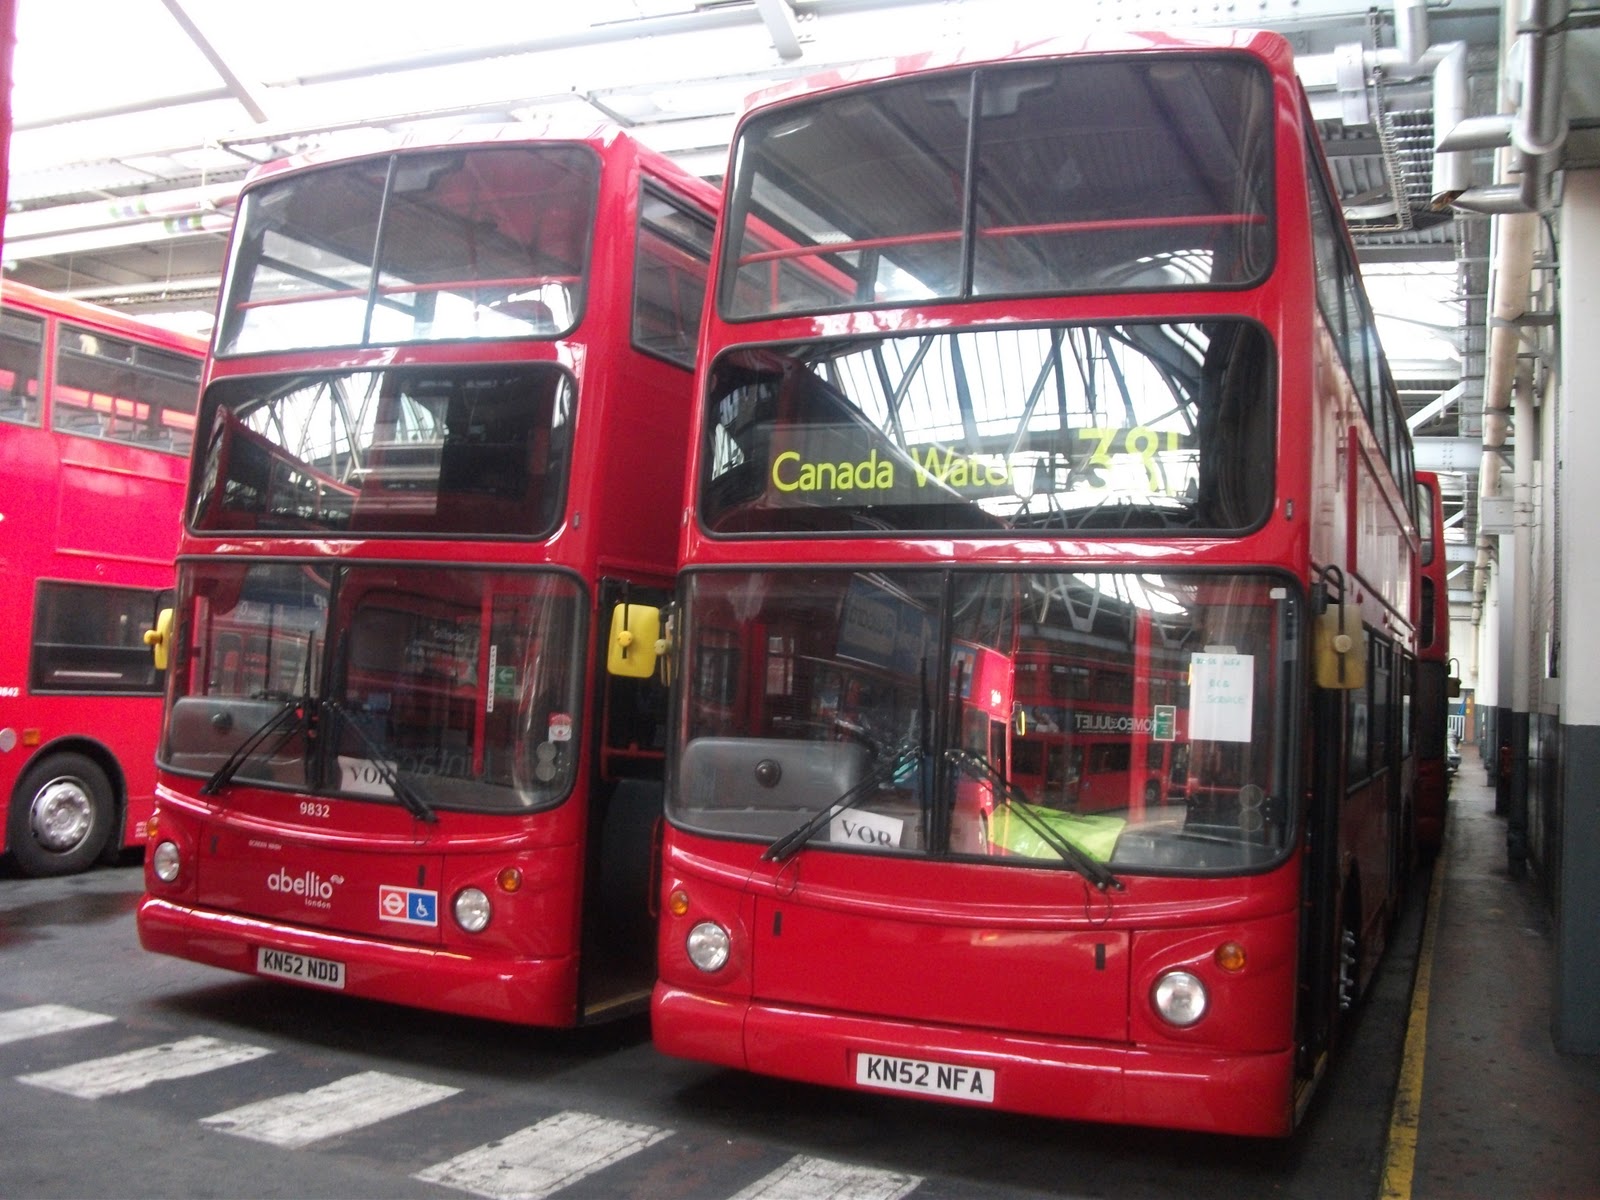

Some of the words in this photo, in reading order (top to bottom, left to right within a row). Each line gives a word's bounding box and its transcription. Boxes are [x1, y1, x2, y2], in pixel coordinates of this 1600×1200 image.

[772, 449, 894, 493] Canada
[911, 446, 1014, 488] Water
[300, 801, 331, 818] 9832
[841, 819, 893, 847] VOR
[267, 866, 333, 899] abellio
[304, 898, 331, 909] london
[263, 950, 303, 975] KN52
[308, 959, 339, 982] NDD
[867, 1057, 929, 1087] KN52
[937, 1065, 984, 1094] NFA
